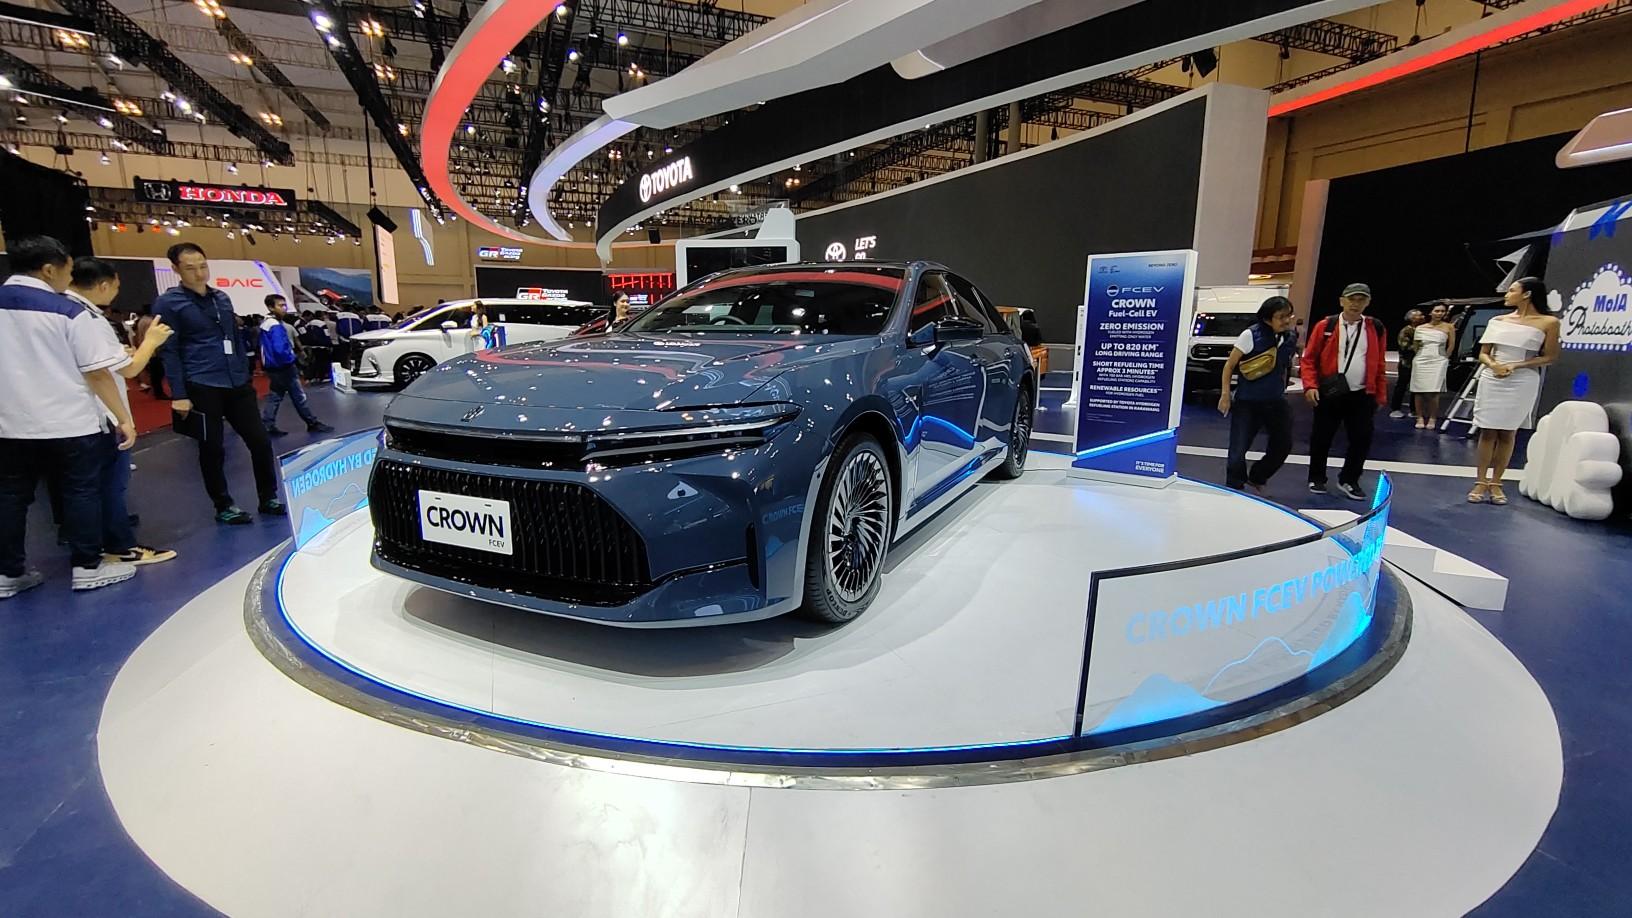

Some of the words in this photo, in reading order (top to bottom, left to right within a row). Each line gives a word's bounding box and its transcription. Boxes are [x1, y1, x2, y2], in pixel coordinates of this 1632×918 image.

[651, 156, 693, 194] TOYOTA
[179, 185, 287, 206] HONDA
[855, 235, 877, 250] LET'S
[479, 250, 499, 258] GR
[1121, 286, 1165, 294] FCEV
[1111, 298, 1156, 308] CROWN
[1108, 309, 1145, 317] Fuel-Cell
[1122, 323, 1165, 331] EMISSION
[1125, 343, 1141, 351] 820
[1113, 361, 1148, 369] REFUELING
[1135, 465, 1165, 474] EVERYONE
[426, 504, 505, 539] CROWN
[488, 538, 505, 548] FCEV
[1125, 592, 1247, 646] CROWN
[1250, 577, 1309, 619] FCEV
